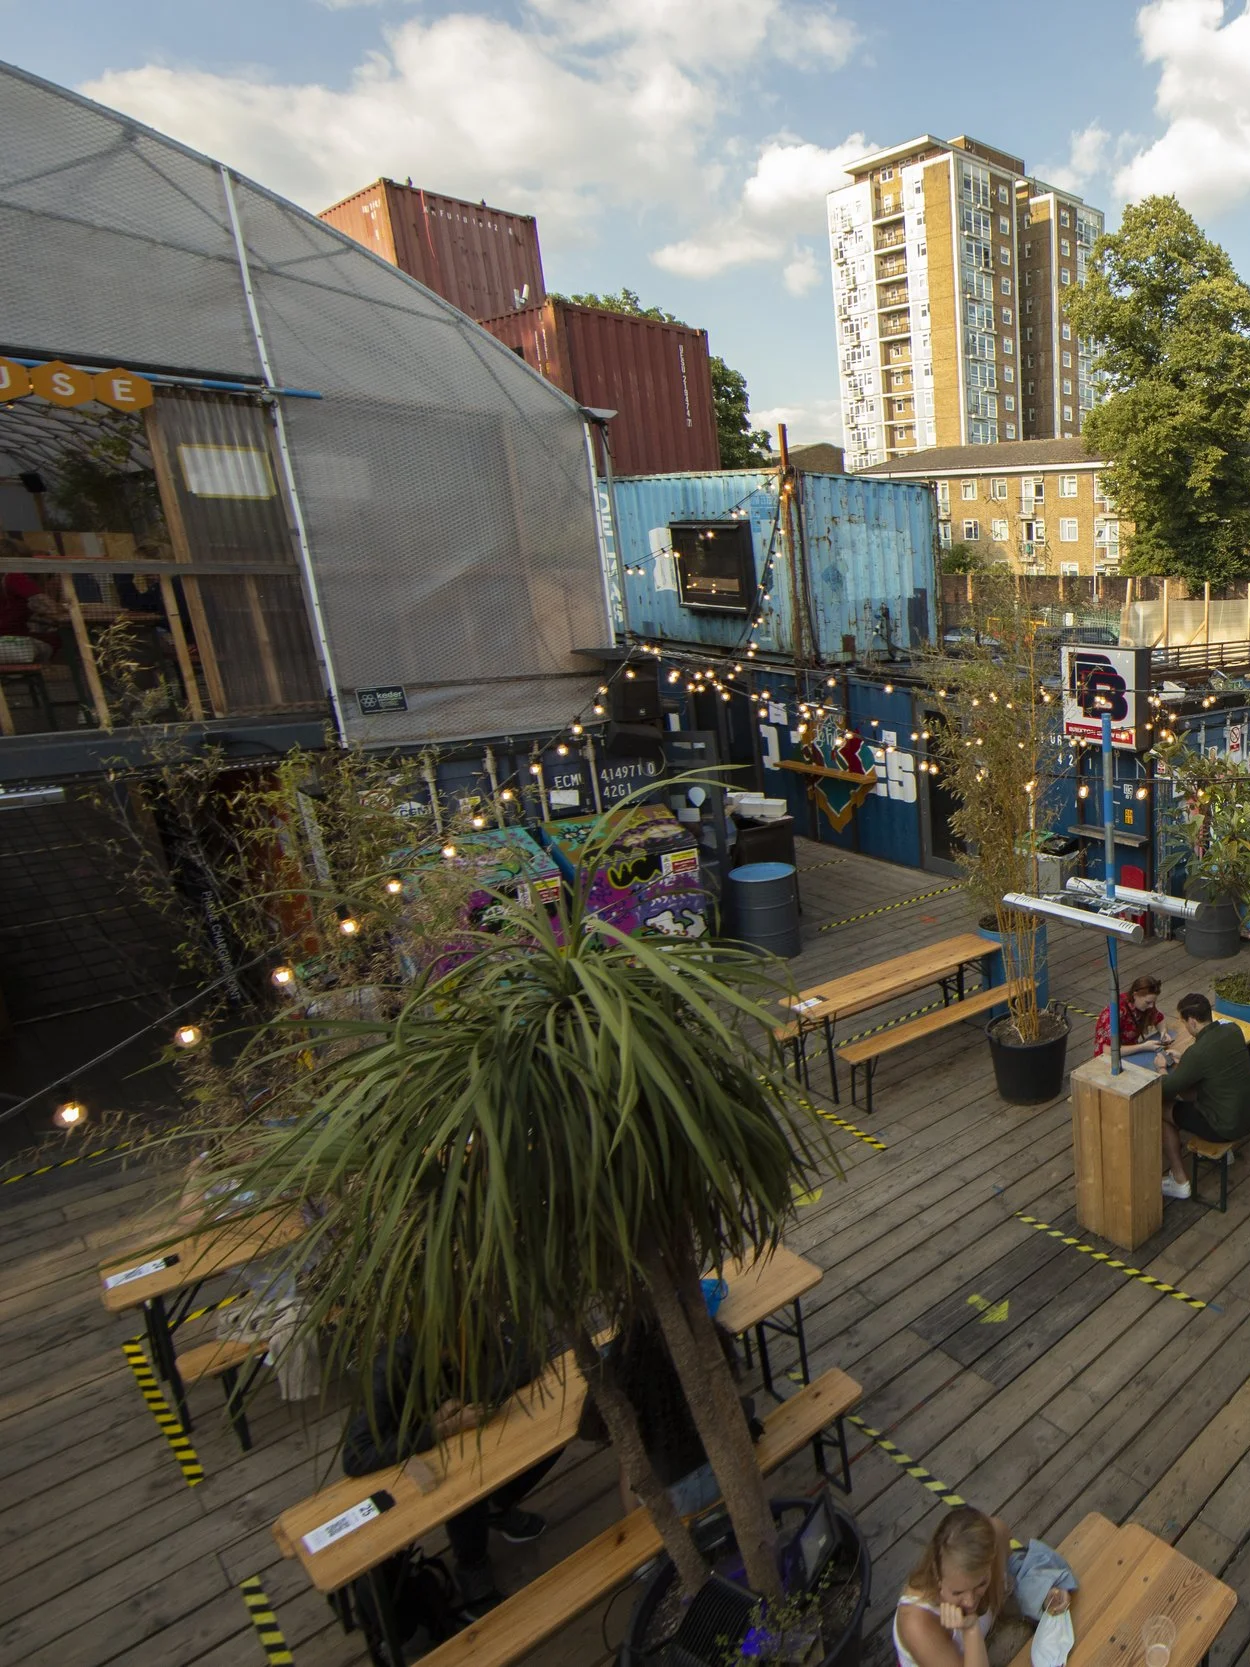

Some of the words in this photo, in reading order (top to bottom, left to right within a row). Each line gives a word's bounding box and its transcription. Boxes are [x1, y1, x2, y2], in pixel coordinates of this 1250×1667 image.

[376, 691, 403, 699] keder
[600, 764, 642, 782] 414971
[647, 762, 656, 775] 0
[603, 783, 632, 798] 42G1
[202, 891, 220, 921] PHONE
[212, 924, 233, 972] CHARGING
[359, 1503, 373, 1517] 25
